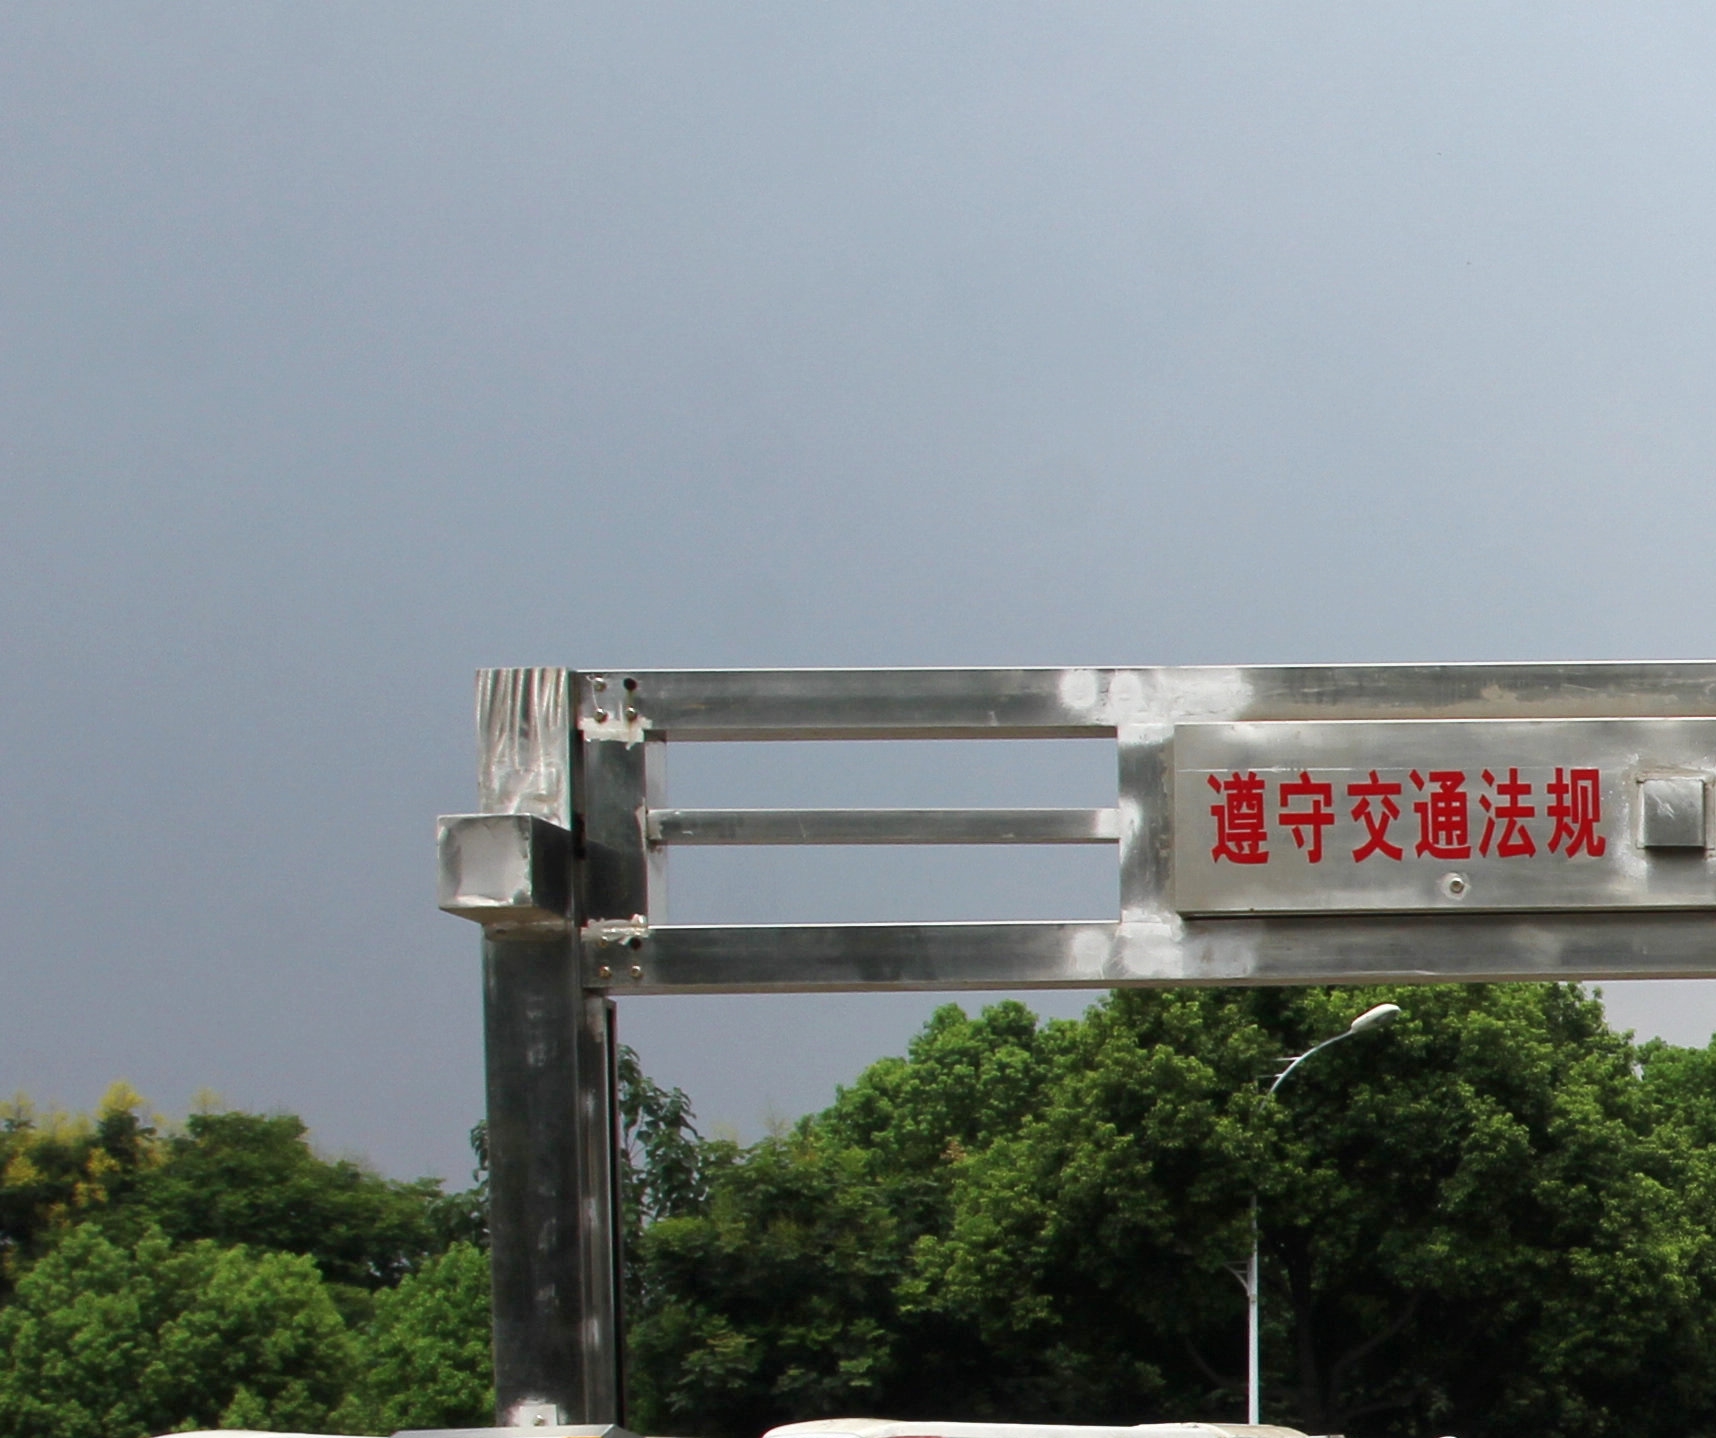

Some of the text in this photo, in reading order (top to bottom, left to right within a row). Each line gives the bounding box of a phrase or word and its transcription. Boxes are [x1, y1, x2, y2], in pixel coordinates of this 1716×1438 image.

[1207, 767, 1607, 866] 遵守交通法规
